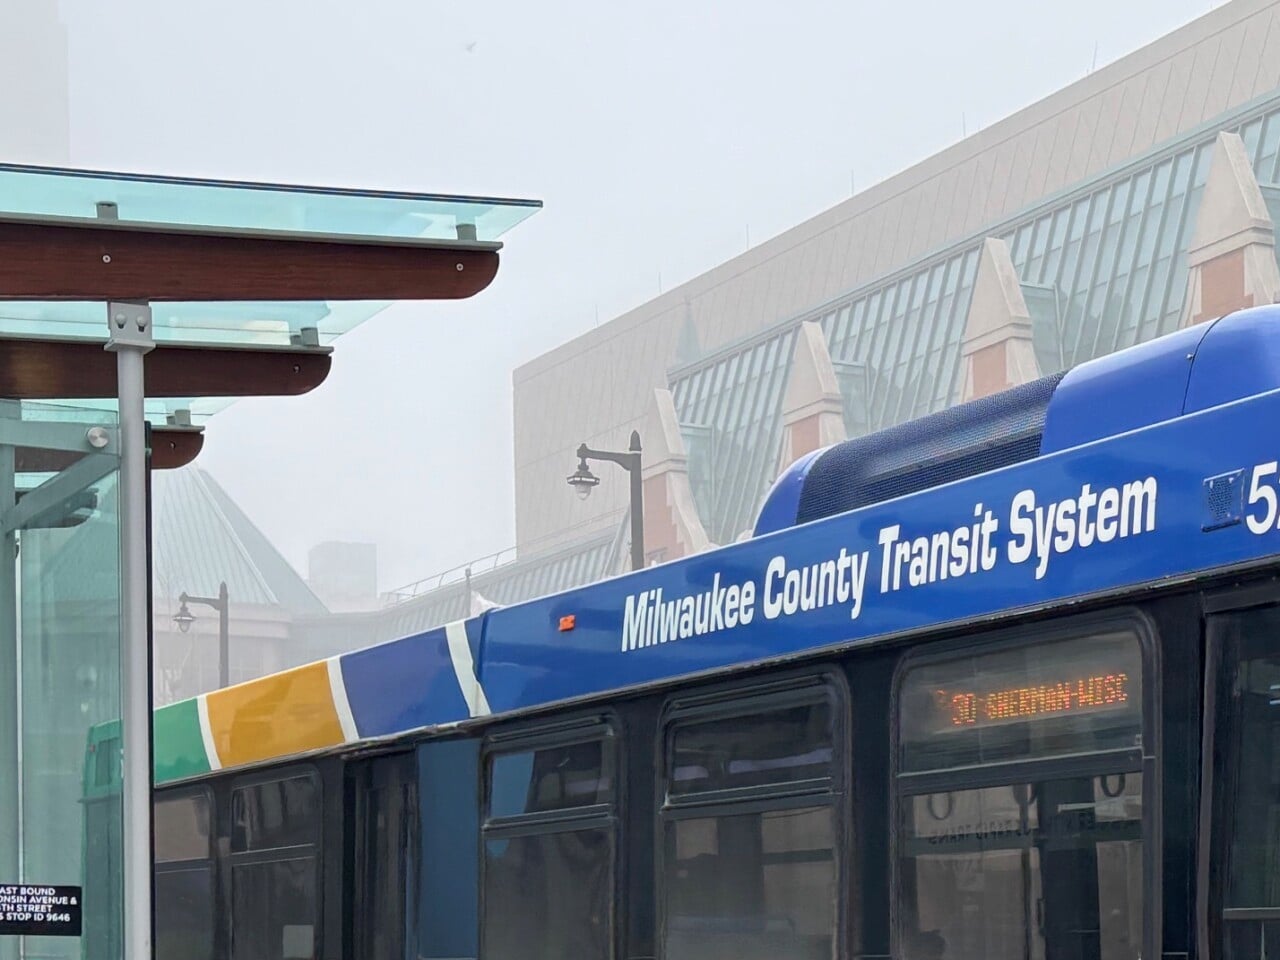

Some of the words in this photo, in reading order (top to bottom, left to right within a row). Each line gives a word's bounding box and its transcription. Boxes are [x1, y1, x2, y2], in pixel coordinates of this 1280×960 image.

[621, 572, 755, 653] Milwaukee
[763, 546, 871, 620] County
[878, 503, 999, 595] Transit
[1007, 476, 1159, 581] System
[20, 887, 56, 895] BOUND
[29, 896, 68, 904] AVENUE
[17, 904, 53, 912] STREET
[6, 913, 31, 921] STOP
[34, 913, 44, 921] ID
[46, 913, 71, 922] 9646
